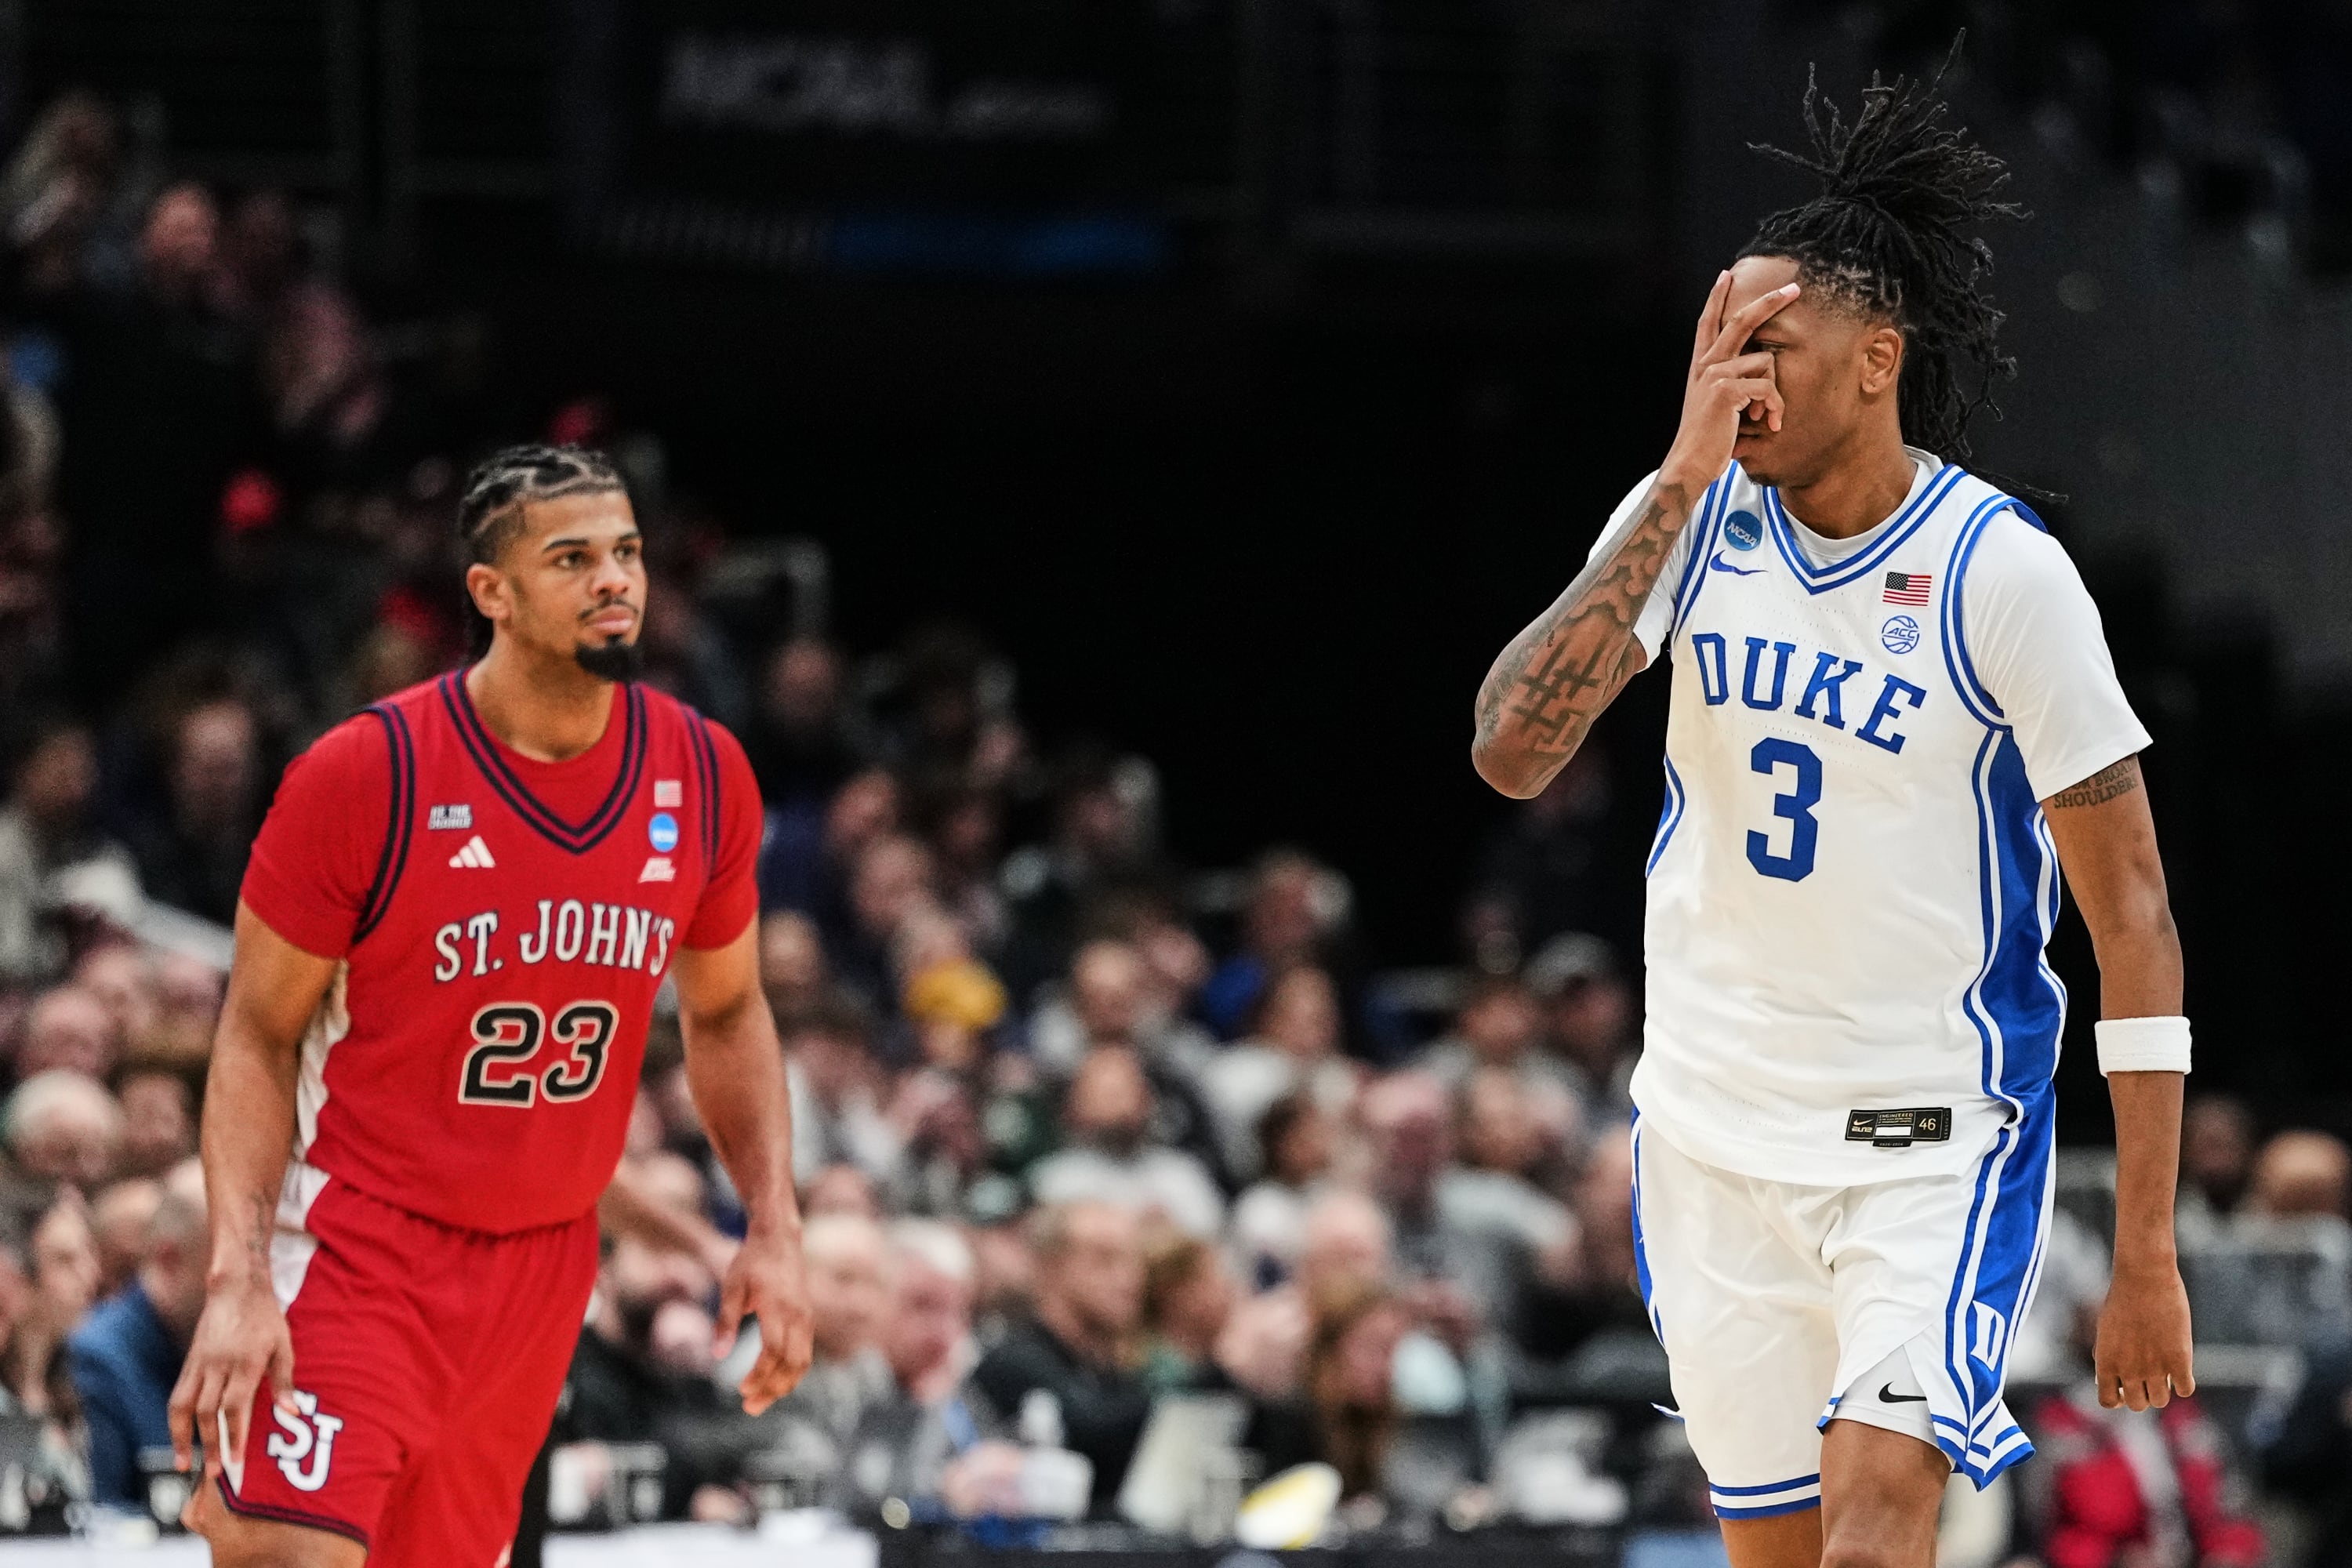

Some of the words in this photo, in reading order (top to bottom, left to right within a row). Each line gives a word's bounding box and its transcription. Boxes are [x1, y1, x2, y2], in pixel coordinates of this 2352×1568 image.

[1726, 521, 1758, 547] NCAA
[1886, 627, 1918, 639] ACC
[1692, 632, 1927, 755] DUKE
[1747, 737, 1823, 882] 3
[434, 911, 503, 983] ST.
[519, 899, 675, 977] JOHN'S
[458, 1000, 620, 1109] 23
[1918, 1117, 1937, 1131] 46
[1970, 1300, 2006, 1372] D
